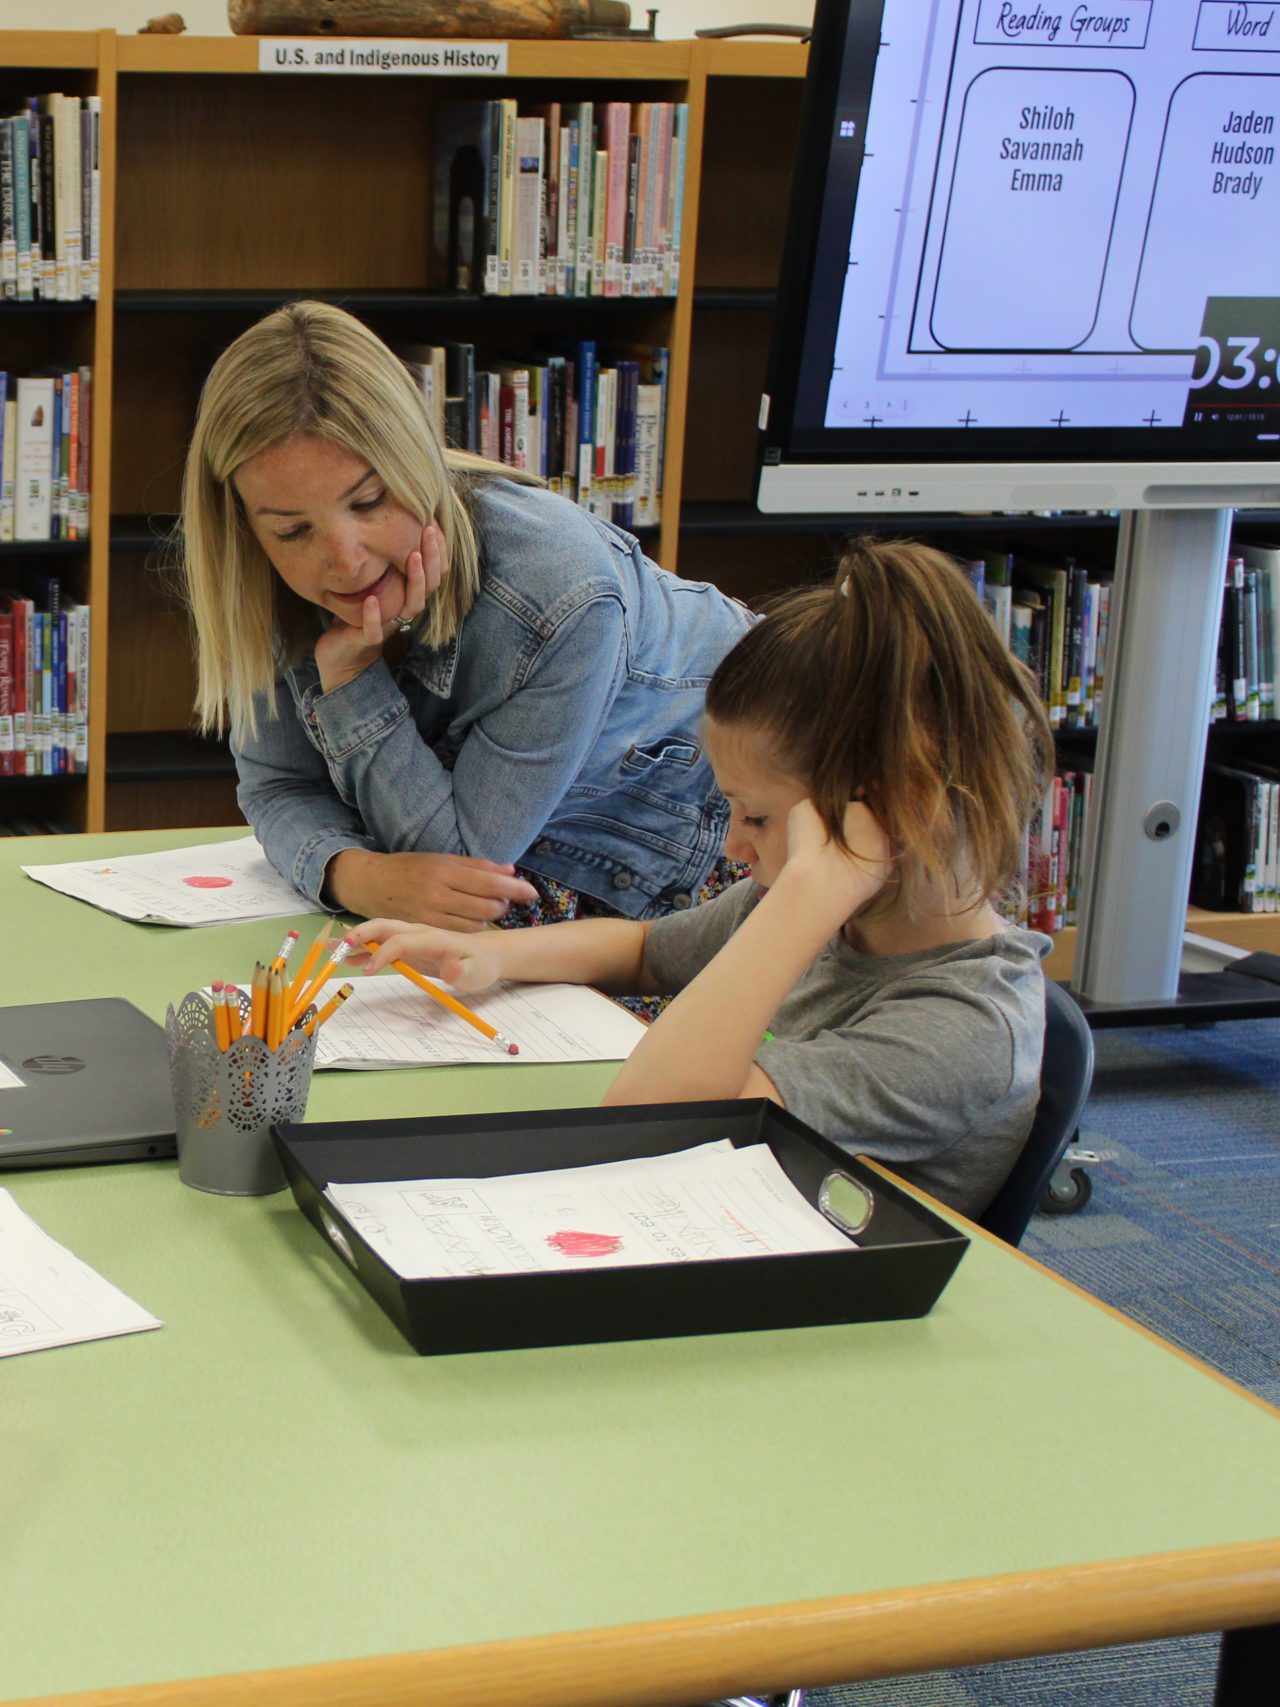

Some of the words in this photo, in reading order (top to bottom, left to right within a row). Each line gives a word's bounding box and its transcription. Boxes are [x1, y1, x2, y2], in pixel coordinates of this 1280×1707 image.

[996, 2, 1062, 42] Reading
[1070, 4, 1131, 43] Groups
[1226, 2, 1275, 37] Word
[274, 48, 309, 65] U.S.
[314, 49, 345, 66] and
[349, 49, 440, 70] Indigenous
[443, 50, 500, 71] History
[1019, 104, 1076, 131] Shiloh
[1222, 110, 1275, 135] Jaden
[999, 137, 1085, 162] Savannah
[1210, 141, 1276, 166] Hudson
[1, 160, 12, 184] THE
[1010, 168, 1064, 193] Emma
[1211, 171, 1264, 201] Brady
[1, 187, 12, 220] DARK
[1189, 335, 1280, 390] 03:
[504, 408, 512, 423] THE
[628, 1210, 656, 1228] eat
